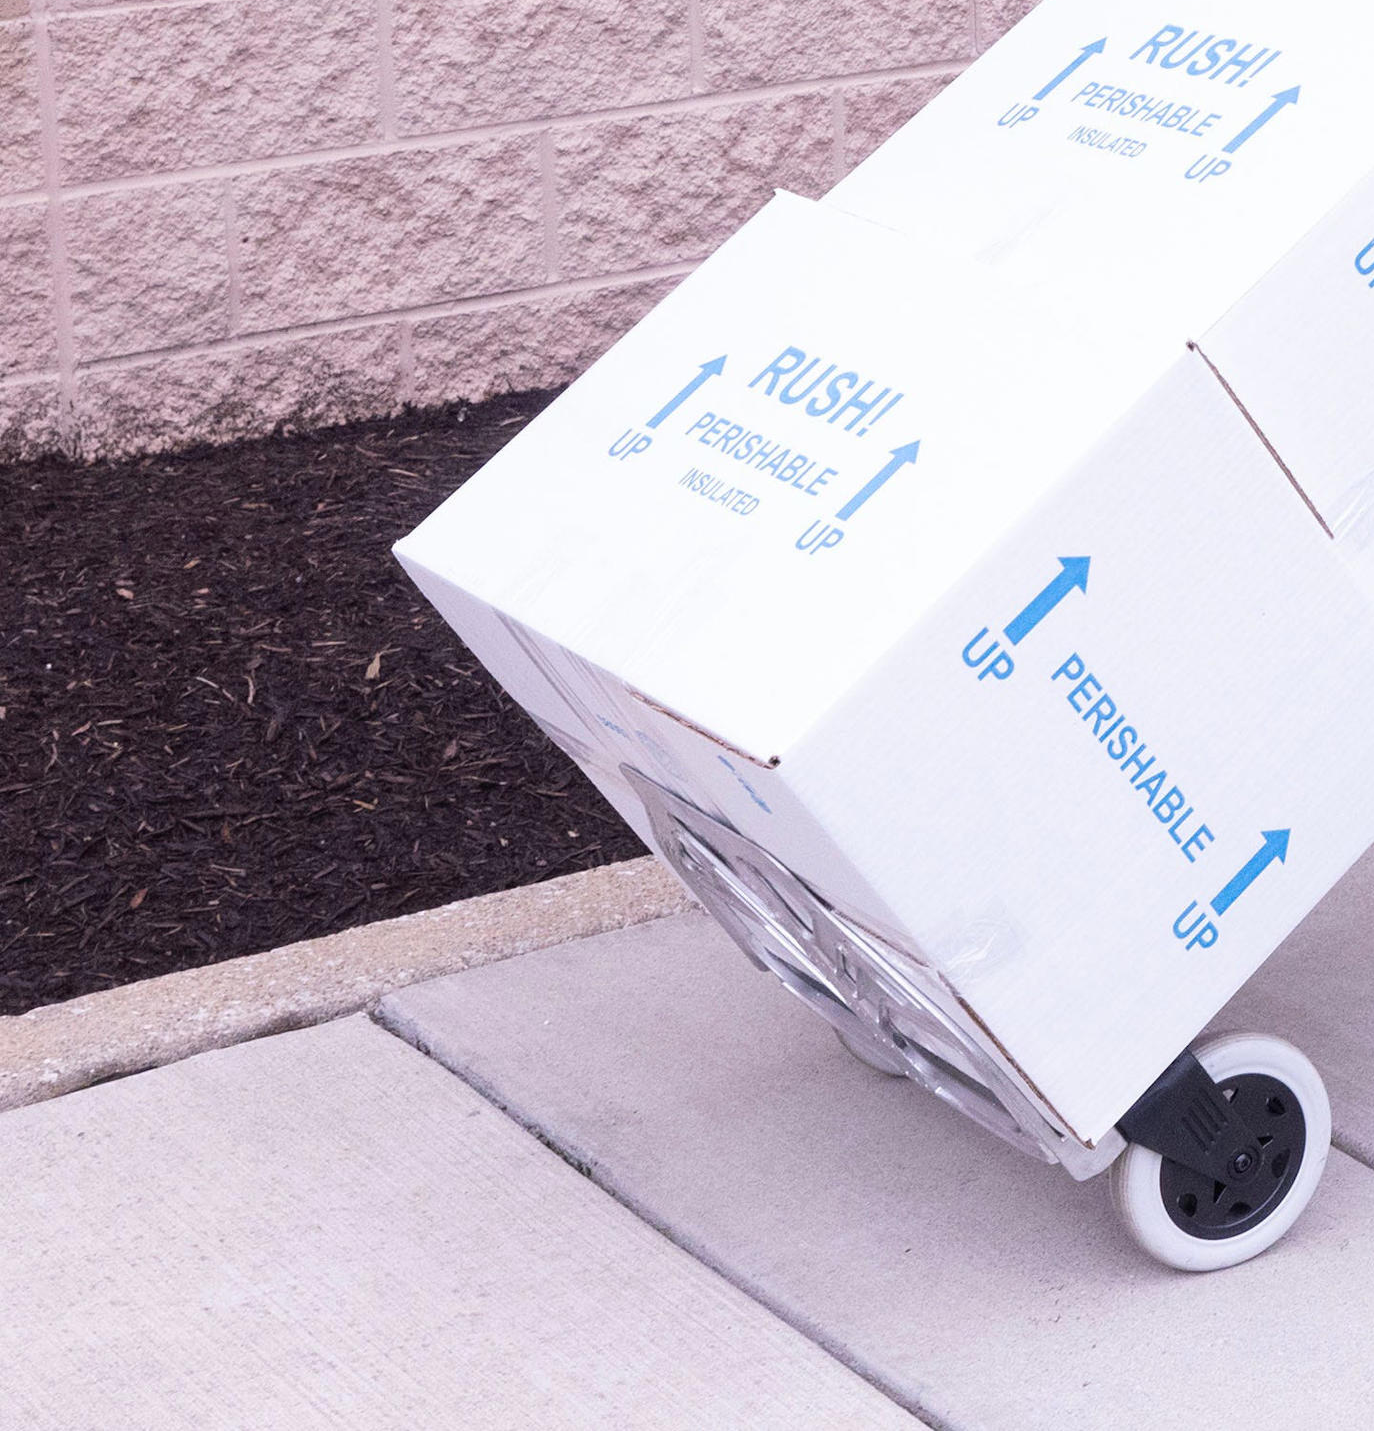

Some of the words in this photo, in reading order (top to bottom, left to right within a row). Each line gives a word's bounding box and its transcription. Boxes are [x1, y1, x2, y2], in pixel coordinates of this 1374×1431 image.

[1129, 24, 1282, 87] RUSH!
[997, 103, 1040, 129] UP
[1071, 81, 1222, 137] PERISHABLE
[1067, 125, 1148, 159] INSULATED
[1184, 154, 1233, 184] UP
[748, 345, 905, 438] RUSH!
[608, 428, 653, 461] UP
[685, 411, 839, 496] PERISHABLE
[679, 467, 761, 516] INSULATED
[794, 519, 845, 556] UP
[961, 626, 1015, 681] UP
[1050, 652, 1216, 863] PERISHABLE
[1172, 900, 1219, 951] UP
